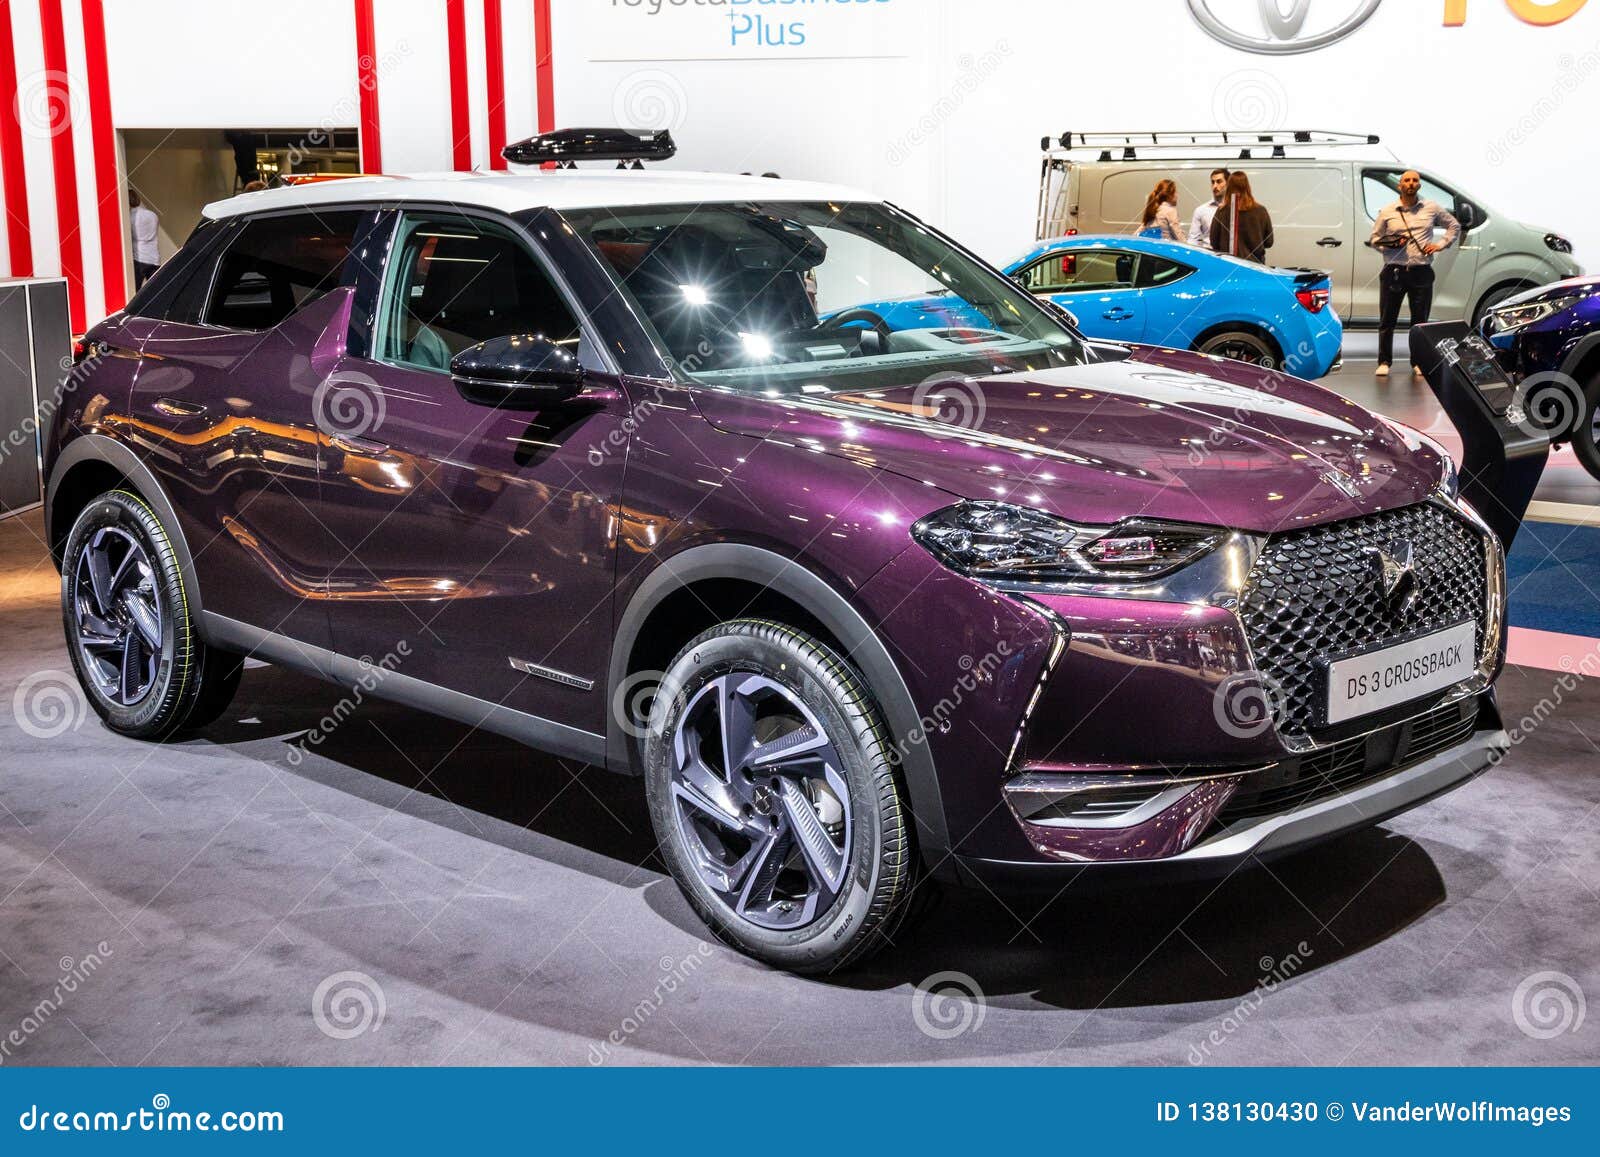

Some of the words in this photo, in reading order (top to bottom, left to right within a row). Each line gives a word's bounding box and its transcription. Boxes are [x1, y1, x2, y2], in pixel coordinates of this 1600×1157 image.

[731, 14, 806, 46] Plus
[1347, 674, 1367, 700] DS
[1371, 671, 1380, 692] 3
[1384, 643, 1463, 689] CROSSBACK
